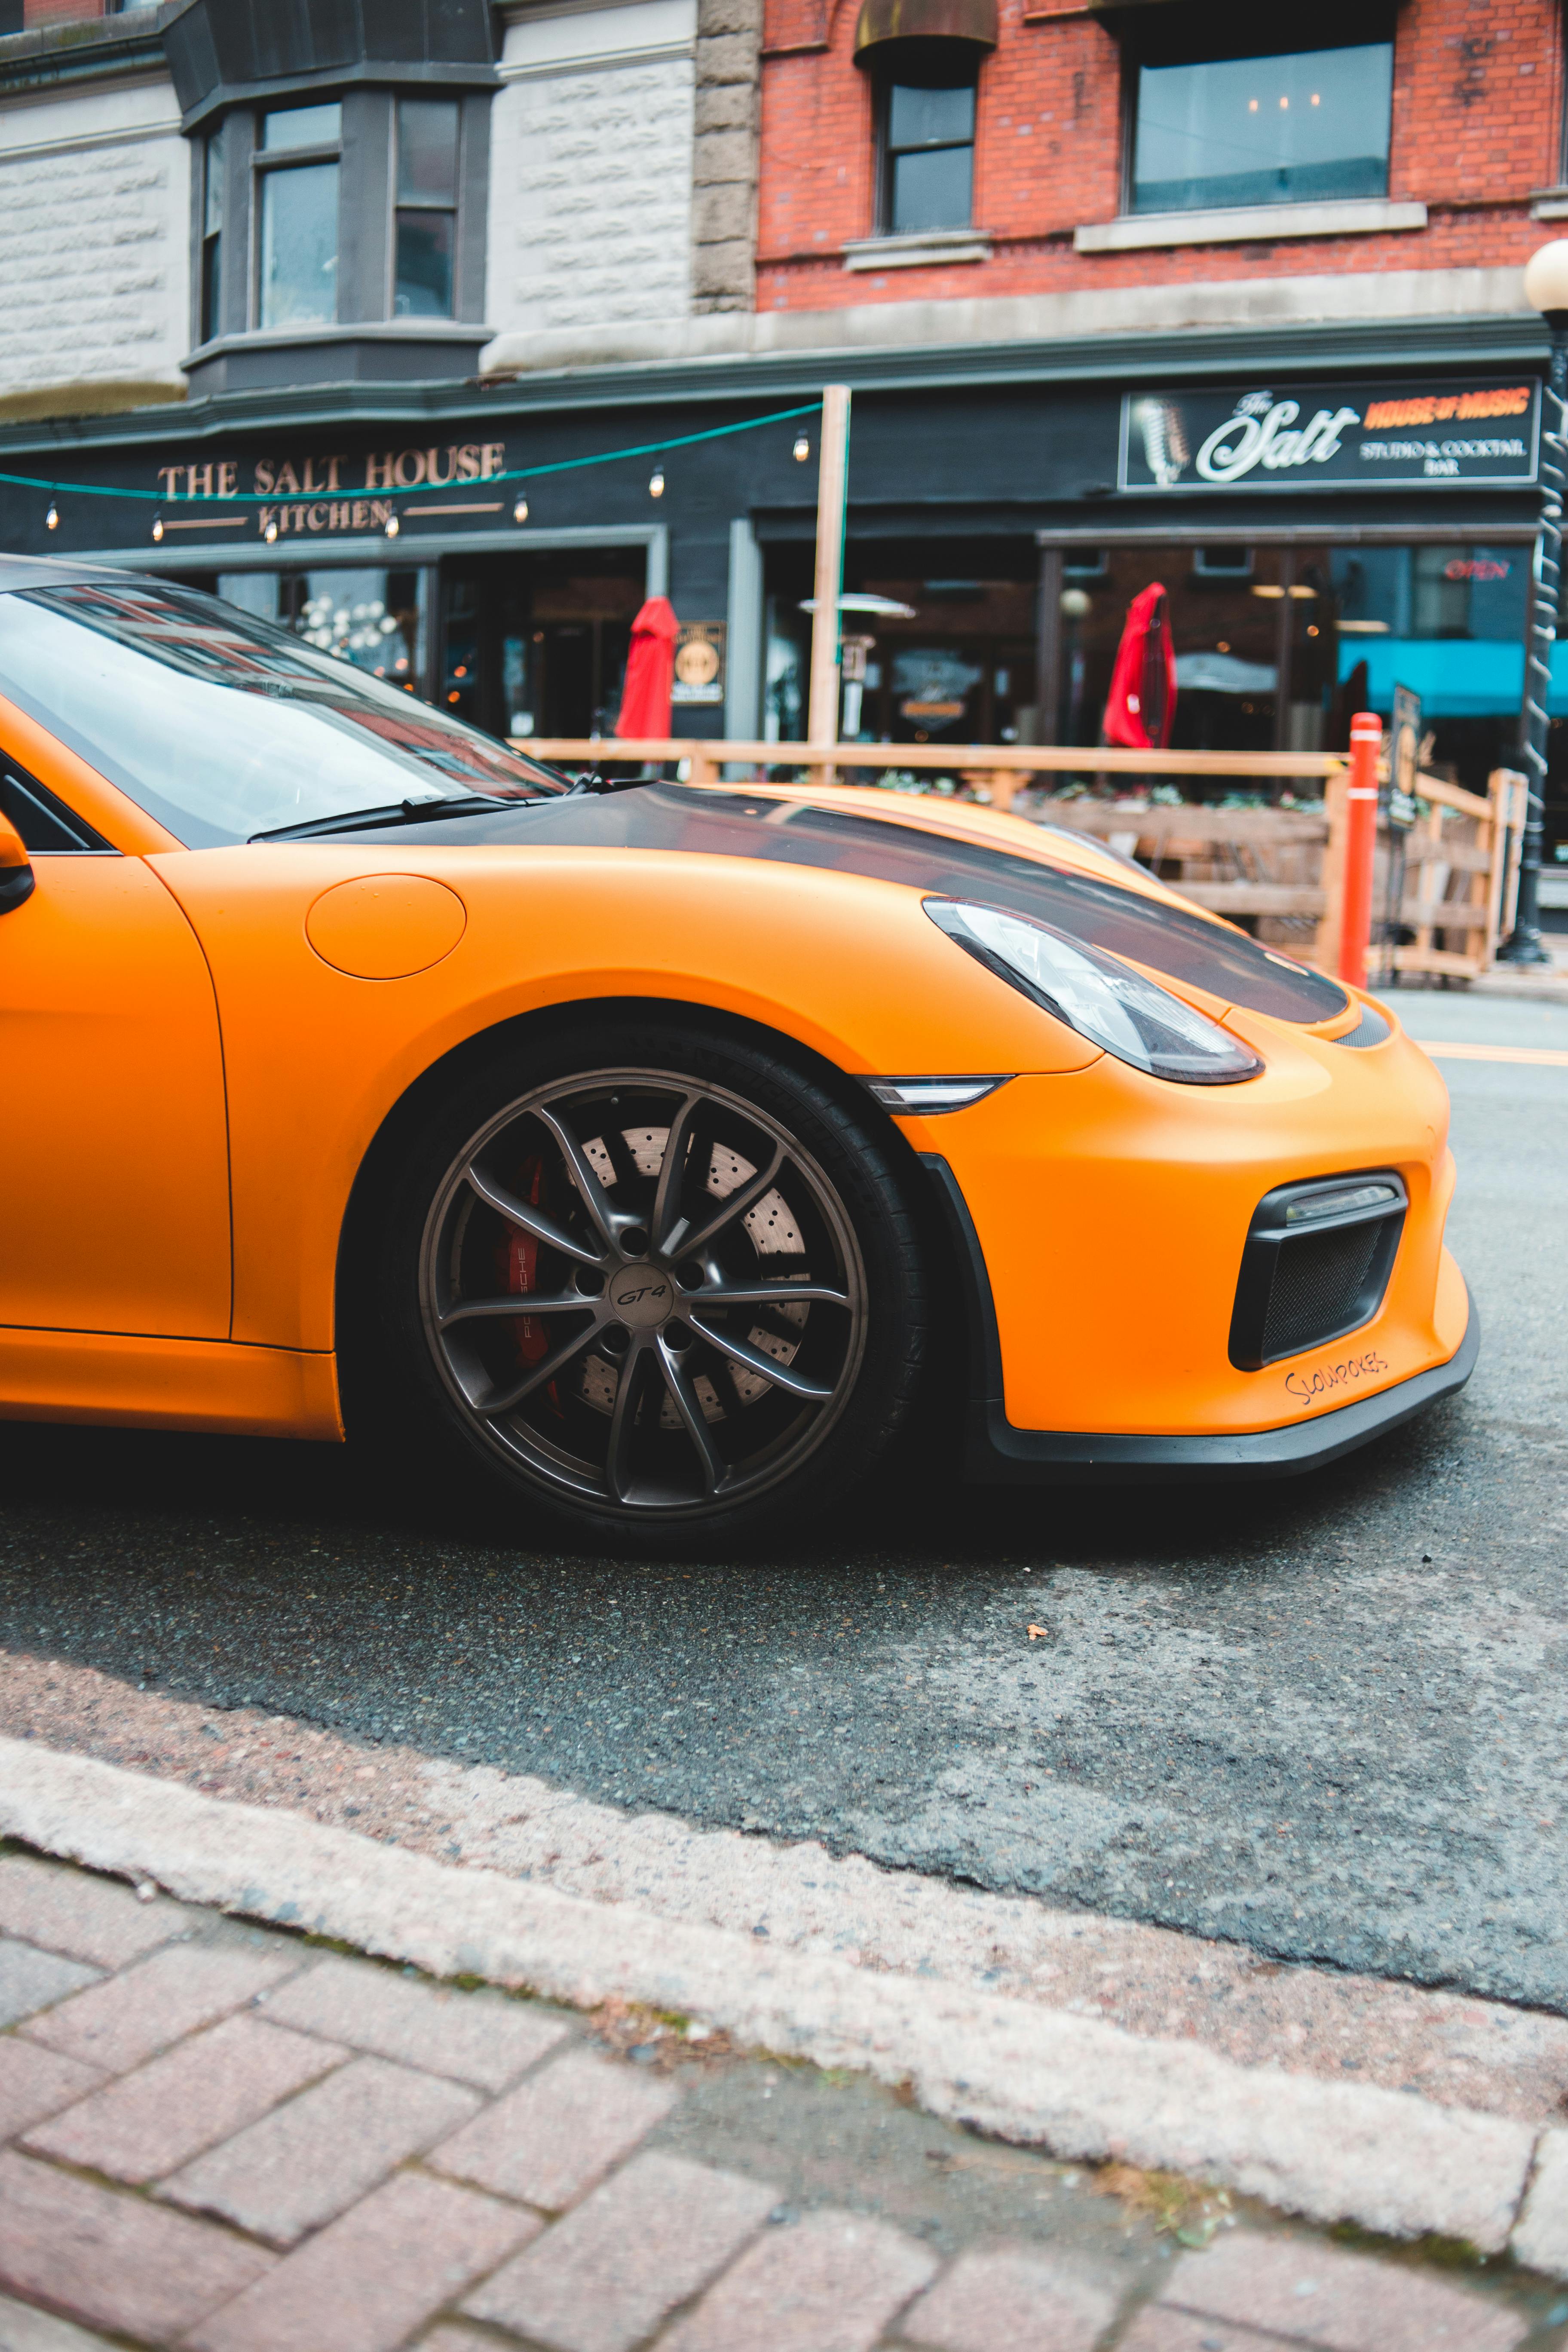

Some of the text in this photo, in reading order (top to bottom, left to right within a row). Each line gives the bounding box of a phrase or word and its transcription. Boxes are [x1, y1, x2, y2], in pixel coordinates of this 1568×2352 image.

[1232, 390, 1274, 416] The
[1363, 395, 1437, 430] HOUSE
[1456, 387, 1530, 420] MUSIC
[1196, 400, 1360, 482] Salt
[1359, 439, 1528, 461] STUDIO & COCKTAIL
[158, 442, 507, 502] THE SALT HOUSE
[1424, 459, 1460, 477] BAR
[258, 499, 393, 534] KITCHEN
[518, 1248, 532, 1338] POSCHE
